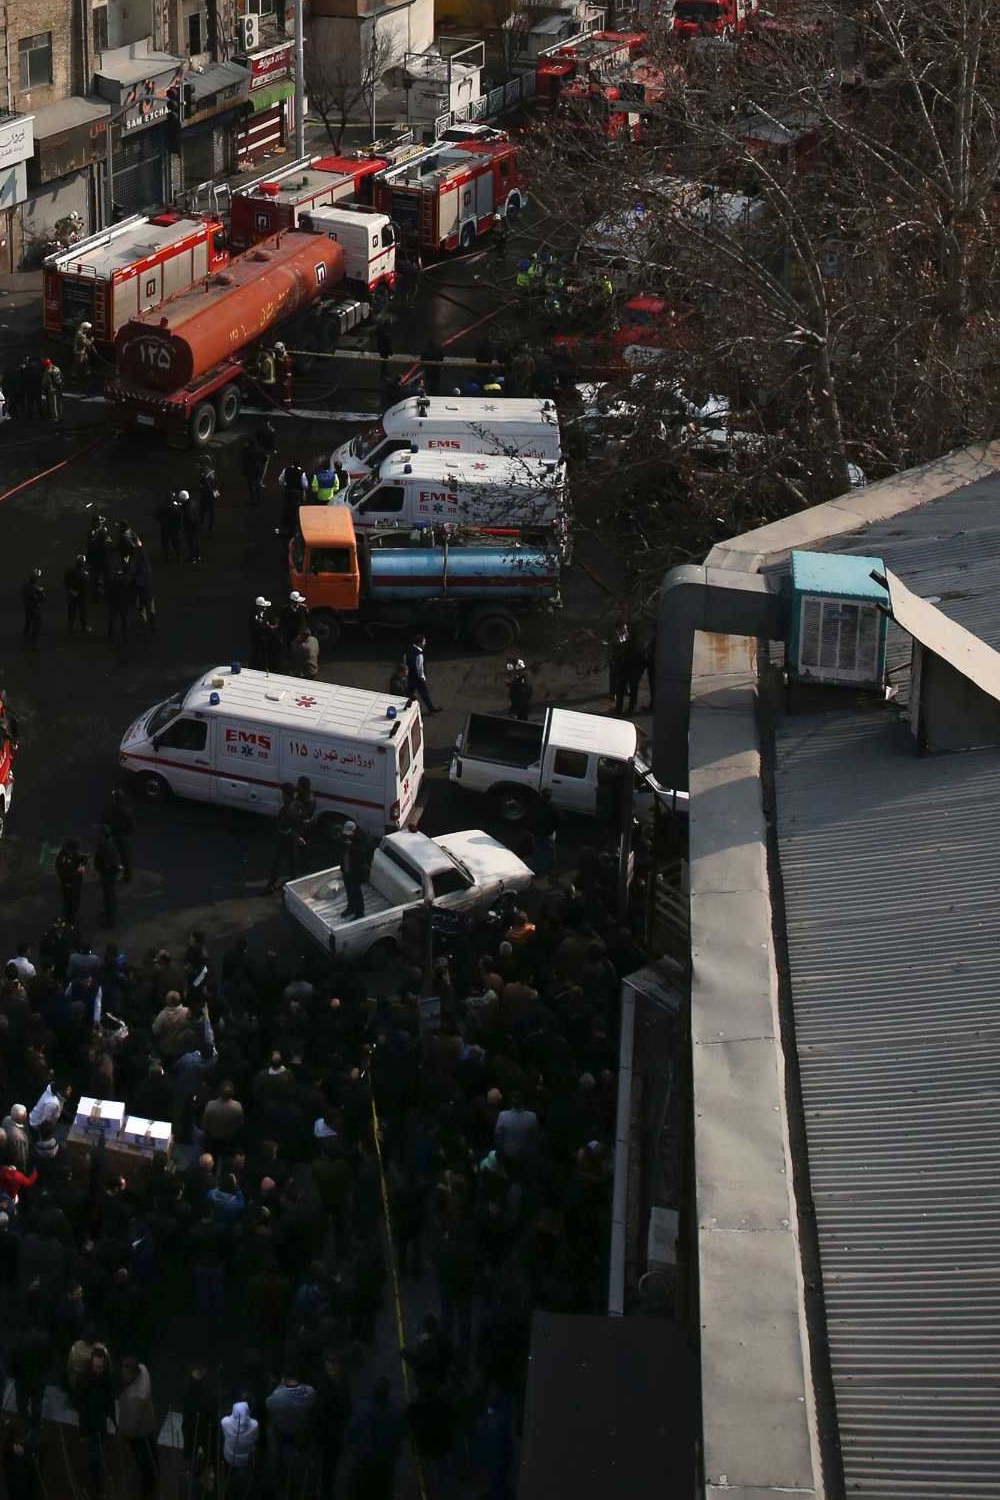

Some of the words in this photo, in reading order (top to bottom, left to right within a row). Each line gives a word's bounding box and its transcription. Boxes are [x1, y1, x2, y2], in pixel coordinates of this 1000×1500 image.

[126, 116, 143, 130] SAM
[145, 105, 171, 122] EXCHA
[140, 343, 170, 369] ۱۲۵
[427, 440, 461, 449] EMS
[419, 491, 458, 505] EMS
[225, 729, 272, 751] EMS
[289, 740, 308, 757] ۱۱۵
[313, 748, 338, 762] تهران
